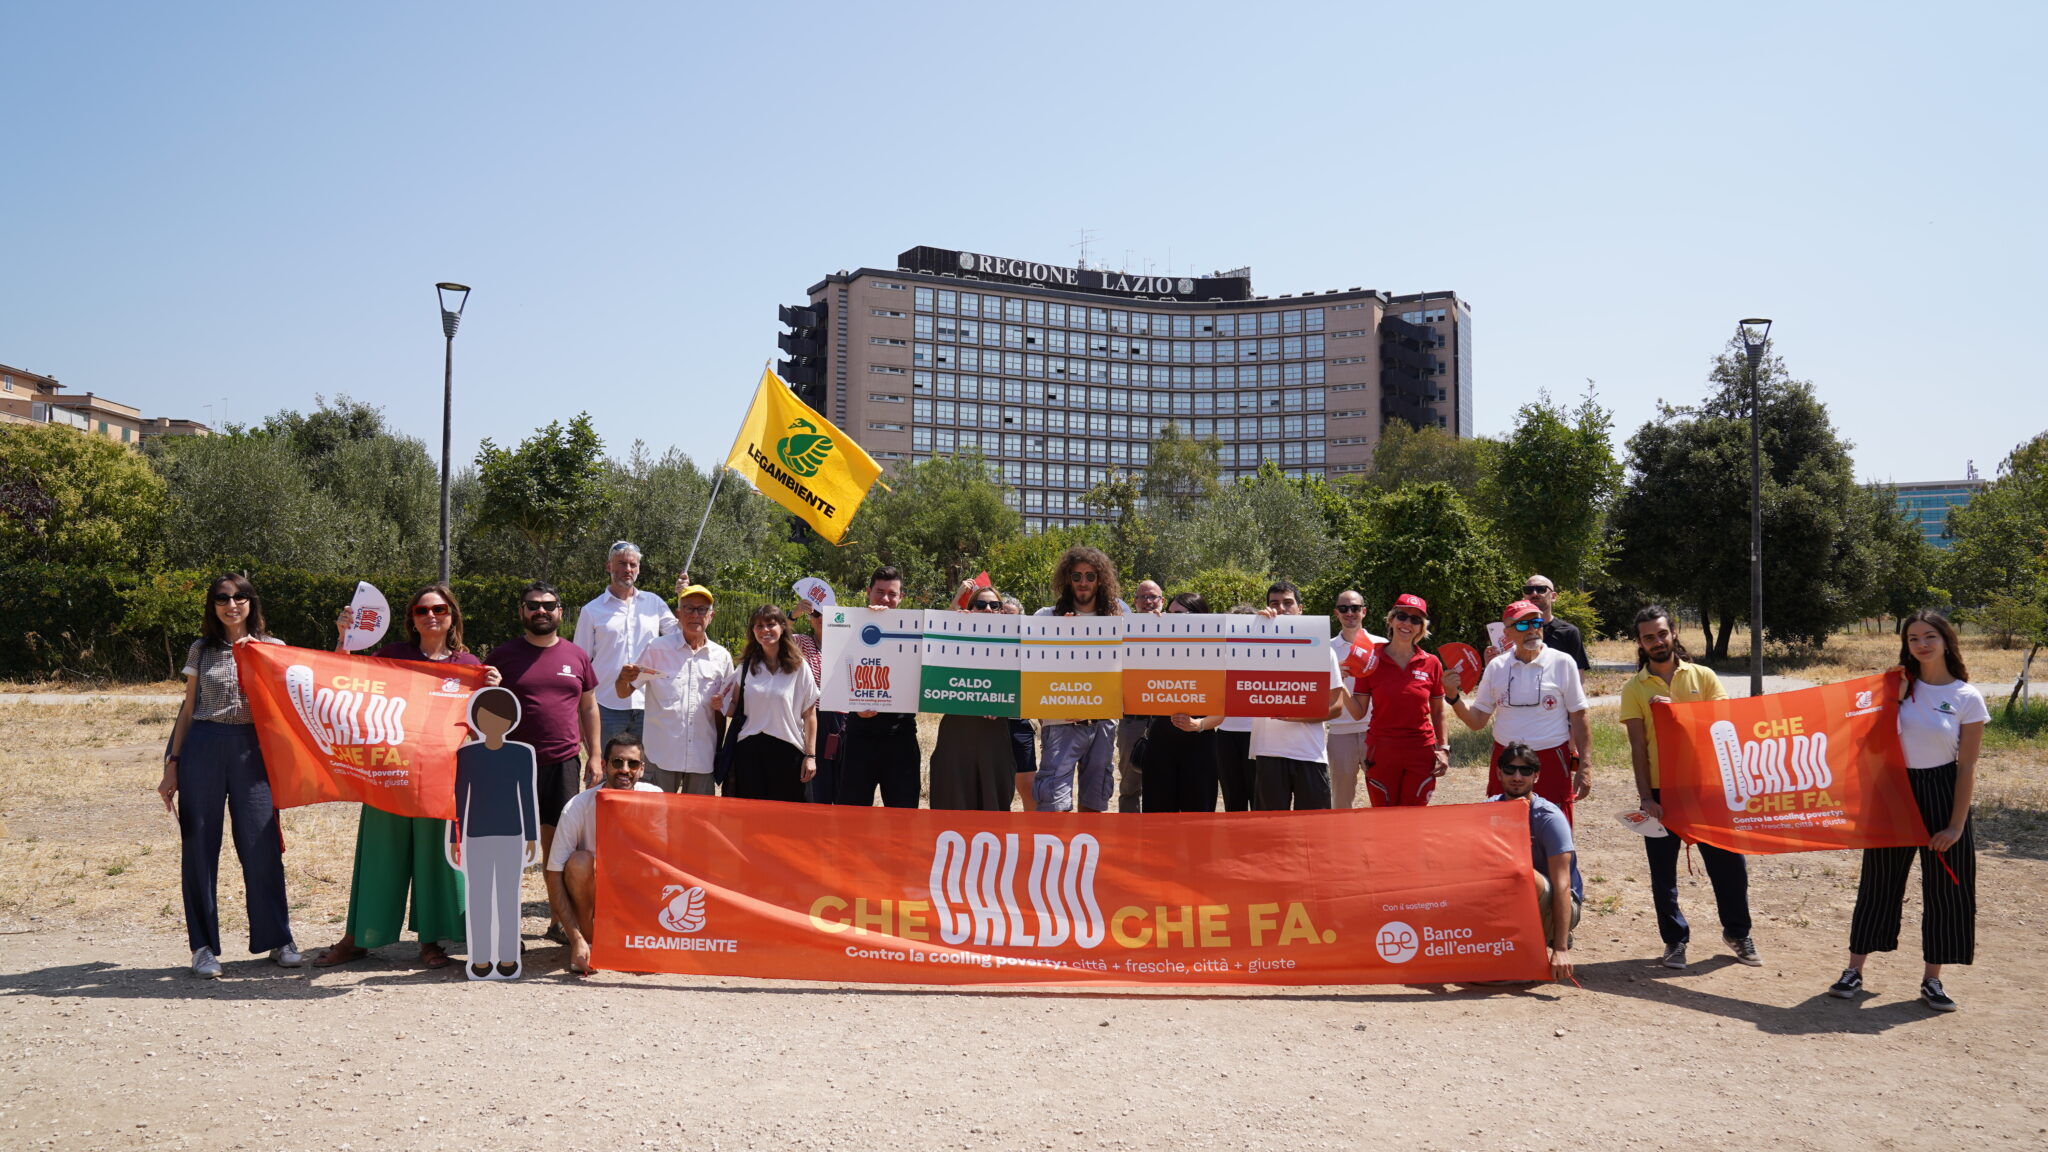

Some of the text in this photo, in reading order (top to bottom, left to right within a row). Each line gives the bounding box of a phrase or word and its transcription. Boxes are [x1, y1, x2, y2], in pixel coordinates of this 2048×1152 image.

[979, 254, 1173, 294] REGIONE LAZIO
[747, 442, 836, 519] LEGAMBIENTE
[861, 657, 881, 666] CHE
[331, 675, 388, 695] CHE
[854, 665, 890, 690] CALDO
[949, 677, 992, 689] CALDO
[1147, 679, 1197, 691] ONDATE
[1049, 681, 1093, 692] CALDO
[1236, 680, 1318, 692] EBOLLIZIONE
[854, 689, 892, 699] CHE FA.
[923, 688, 1016, 704] SOPPORTABILE
[1039, 695, 1103, 706] ANOMALO
[1141, 692, 1207, 704] DI CALORE
[1248, 694, 1307, 705] GLOBALE
[312, 687, 407, 746] CALDO
[1753, 716, 1804, 740] CHE
[370, 747, 410, 767] FA.
[1741, 731, 1833, 798] CALDO
[372, 769, 409, 779] poverty:
[384, 778, 409, 788] giuste
[1746, 790, 1842, 814] CHE FA.
[1733, 816, 1763, 824] Contro
[1773, 812, 1806, 821] cooling
[1806, 810, 1844, 819] poverty:
[1822, 818, 1848, 827] giuste
[808, 830, 1337, 949] CHE CALDO CHE FA.
[1382, 900, 1448, 912] Con il sostegno di
[1423, 926, 1473, 941] Banco
[625, 935, 738, 953] LEGAMBIENTE
[1425, 938, 1515, 957] dell'energia
[845, 946, 906, 962] Contro
[909, 949, 925, 962] la
[928, 951, 992, 968] cooling
[996, 956, 1068, 970] poverty:
[1072, 959, 1108, 971] città
[1125, 959, 1190, 975] fresche,
[1193, 958, 1229, 972] città
[1247, 958, 1297, 974] giuste
